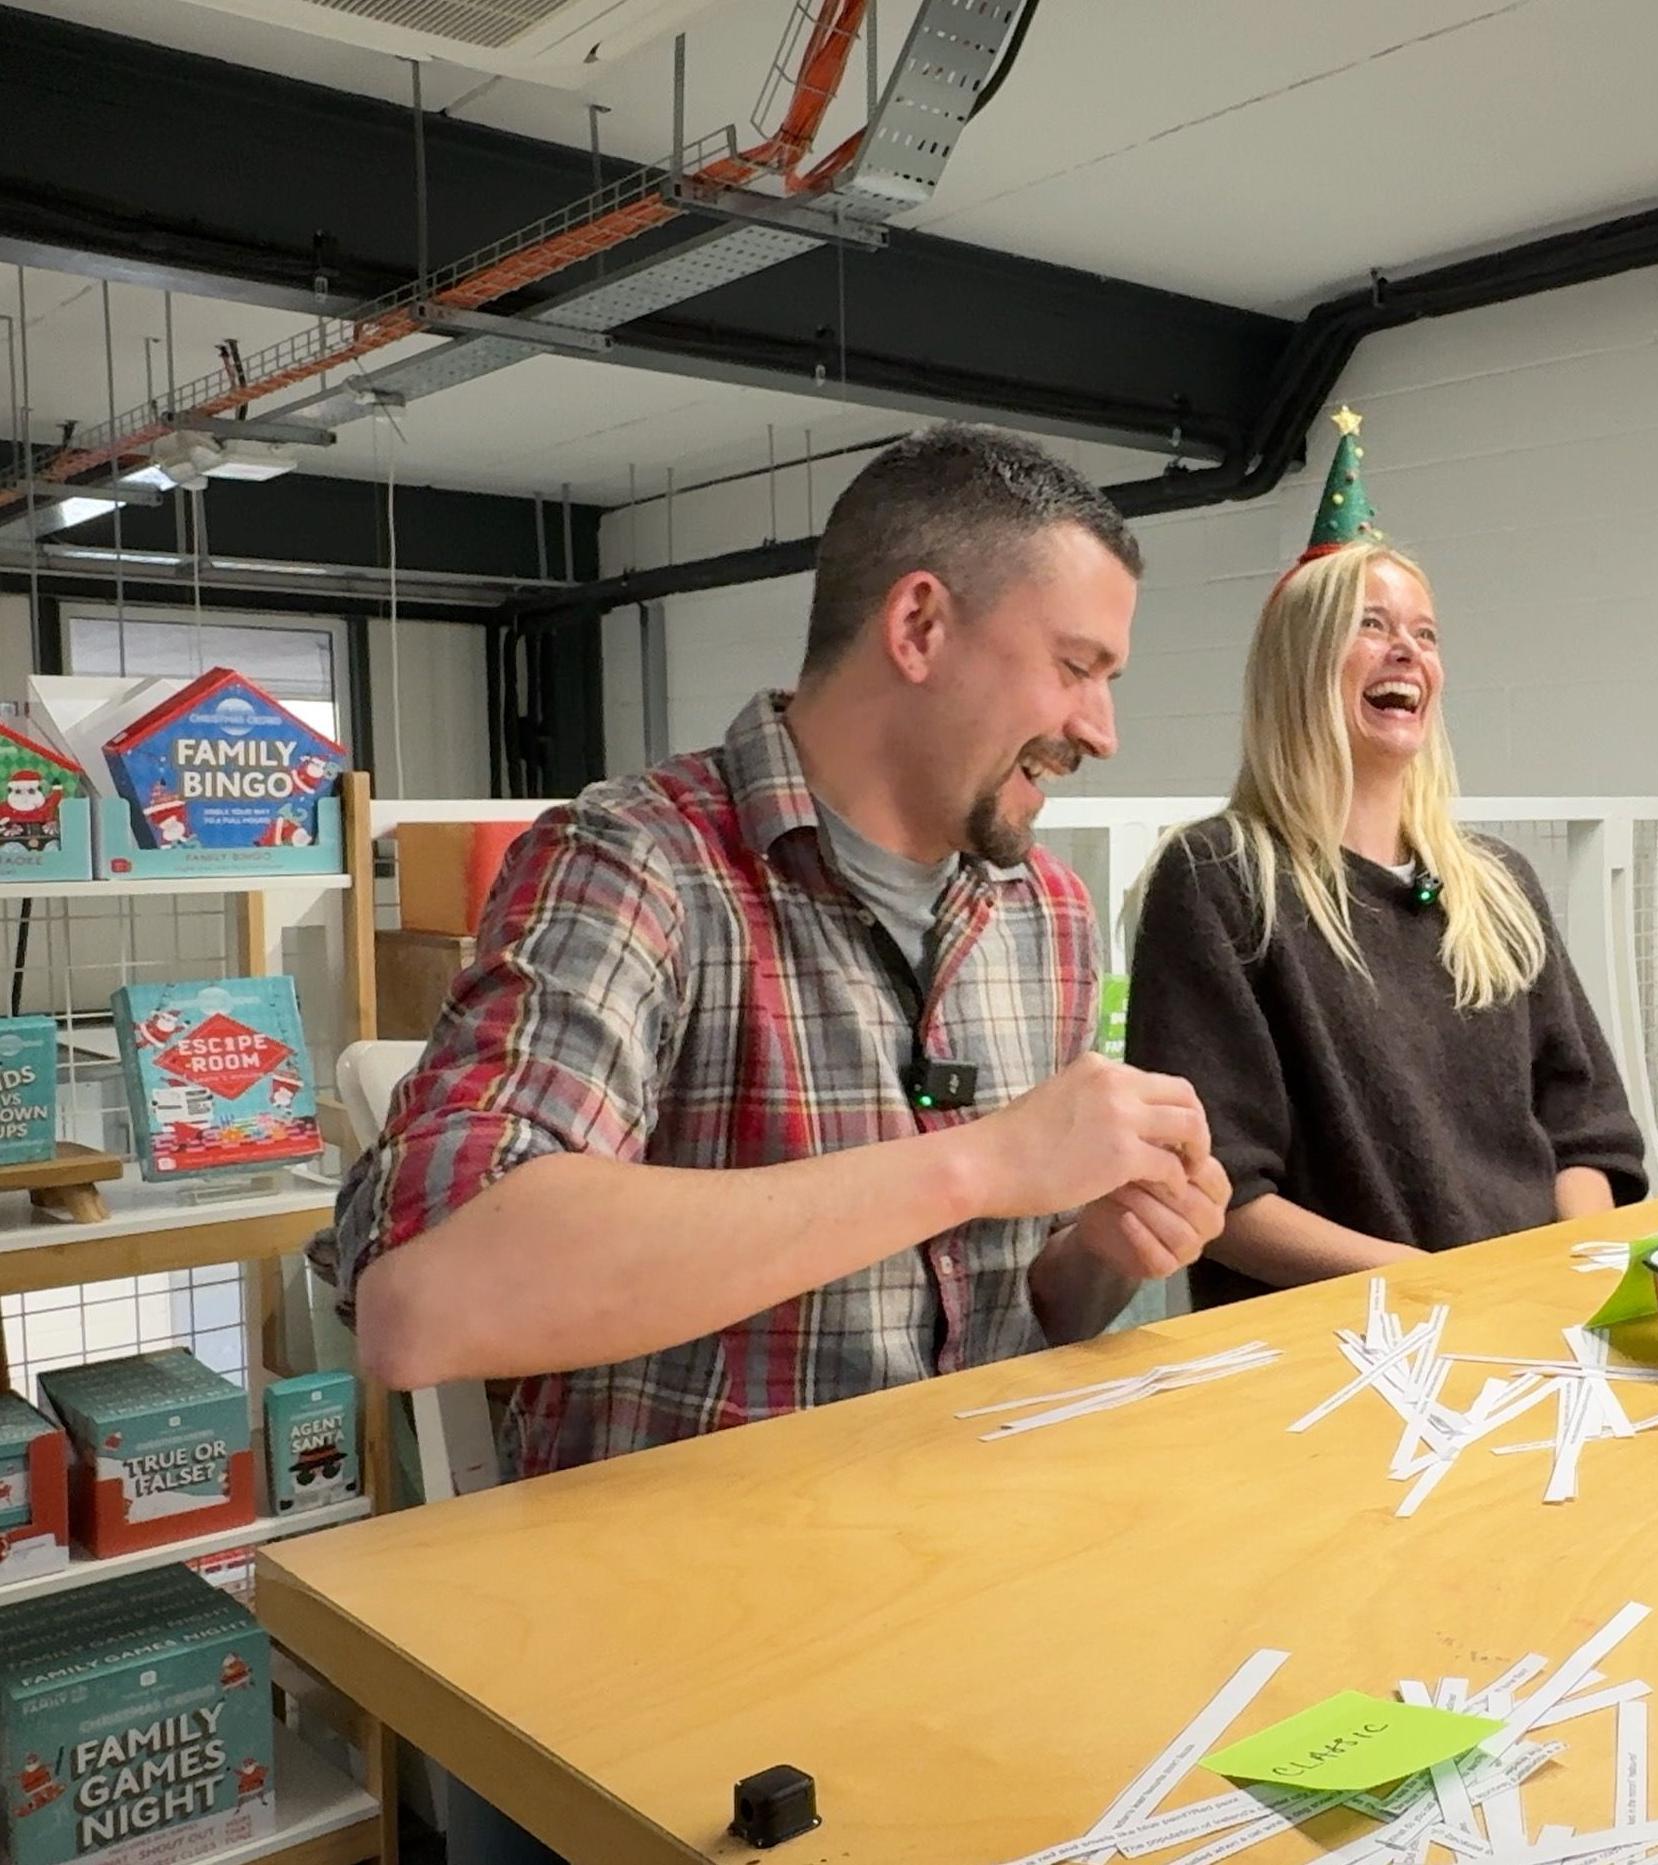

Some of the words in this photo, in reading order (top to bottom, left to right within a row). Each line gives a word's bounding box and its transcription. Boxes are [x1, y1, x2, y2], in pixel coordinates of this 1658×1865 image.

[177, 738, 298, 766] FAMILY
[183, 770, 294, 798] BINGO
[191, 1052, 261, 1073] ROOM
[0, 1065, 37, 1091] DS
[0, 1104, 48, 1123] OWN
[289, 1415, 346, 1440] AGENT
[126, 1446, 189, 1475] TRUE
[194, 1439, 227, 1461] OR
[290, 1431, 345, 1455] SANTA
[140, 1463, 217, 1494] FALSE?
[21, 1658, 99, 1687] FAMILY
[104, 1638, 178, 1663] GAMES
[183, 1619, 249, 1642] NIGHT
[76, 1701, 226, 1775] FAMILY
[80, 1740, 227, 1809] GAMES
[82, 1775, 225, 1847] NIGHT
